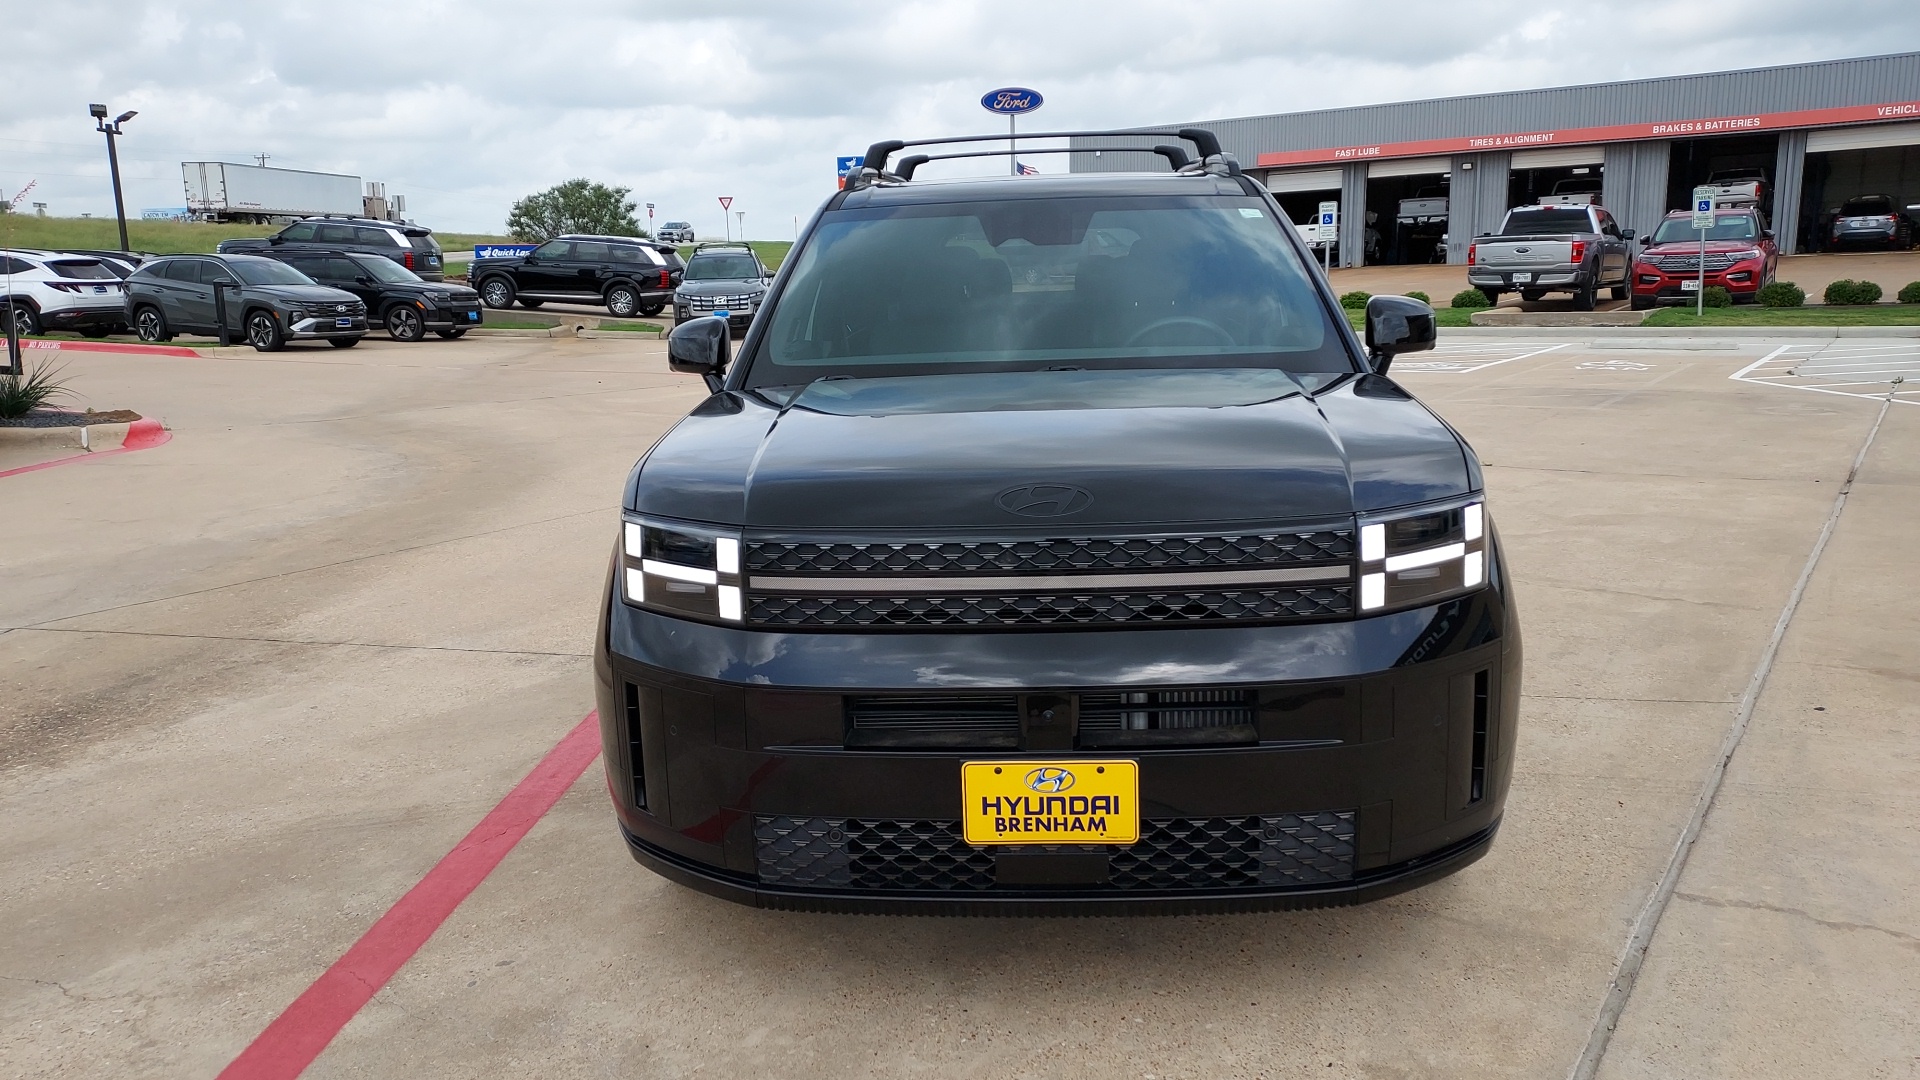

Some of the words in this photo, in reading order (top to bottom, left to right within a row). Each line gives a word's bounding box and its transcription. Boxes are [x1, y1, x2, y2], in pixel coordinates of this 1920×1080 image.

[993, 91, 1031, 109] Ford
[1877, 104, 1920, 116] VEHICL
[1652, 123, 1693, 134] BRAKES
[1696, 122, 1702, 131] &
[1704, 118, 1761, 130] BATTERIES
[1469, 137, 1494, 147] TIRES
[1496, 136, 1502, 145] &
[1503, 133, 1555, 144] ALIGNMENT
[1335, 148, 1356, 158] FAST
[1358, 147, 1380, 156] LUBE
[491, 248, 514, 257] Quick
[981, 796, 1119, 815] HYUNDAI
[995, 817, 1107, 832] BRENHAM
